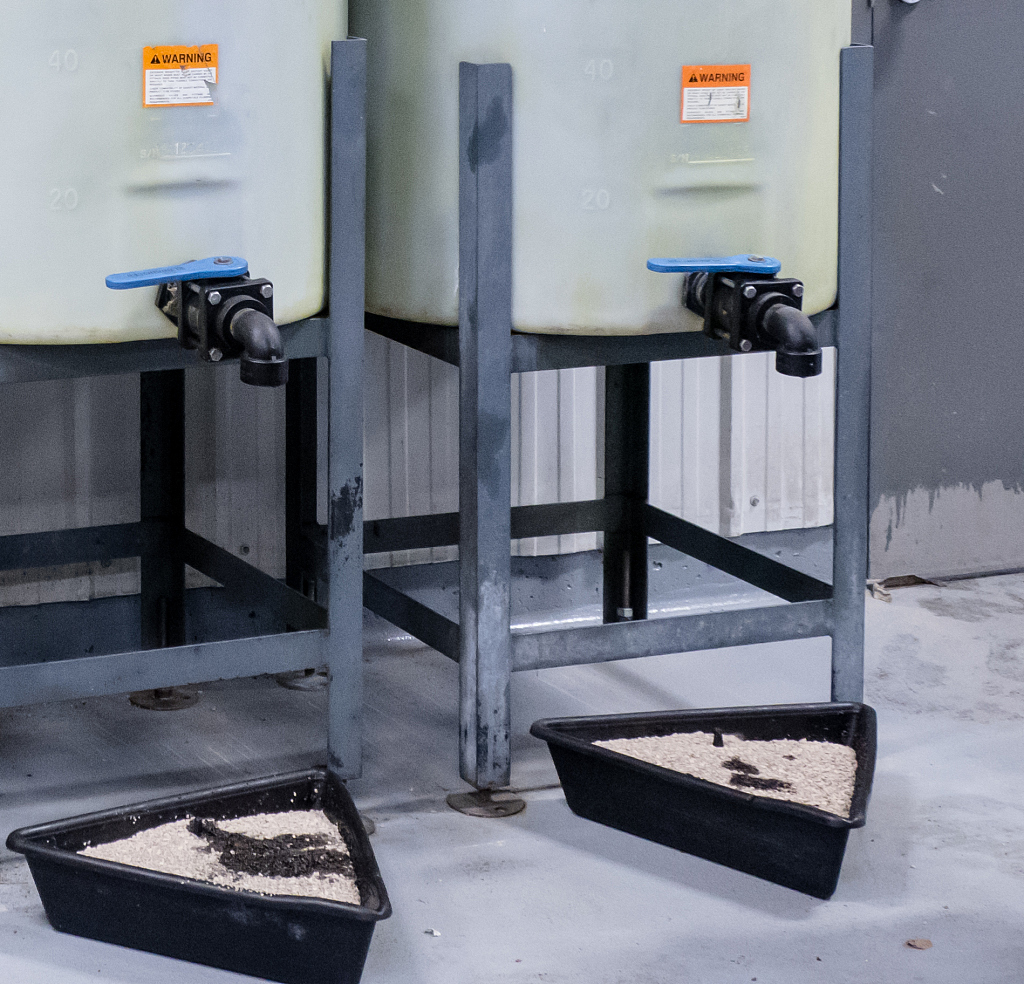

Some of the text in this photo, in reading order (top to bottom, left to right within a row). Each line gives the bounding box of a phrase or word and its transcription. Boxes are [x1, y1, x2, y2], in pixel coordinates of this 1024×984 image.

[48, 48, 78, 72] 40
[162, 53, 212, 64] WARNING
[584, 58, 614, 81] 40
[699, 72, 745, 83] WARNING
[50, 186, 78, 211] 20
[581, 188, 610, 210] 20
